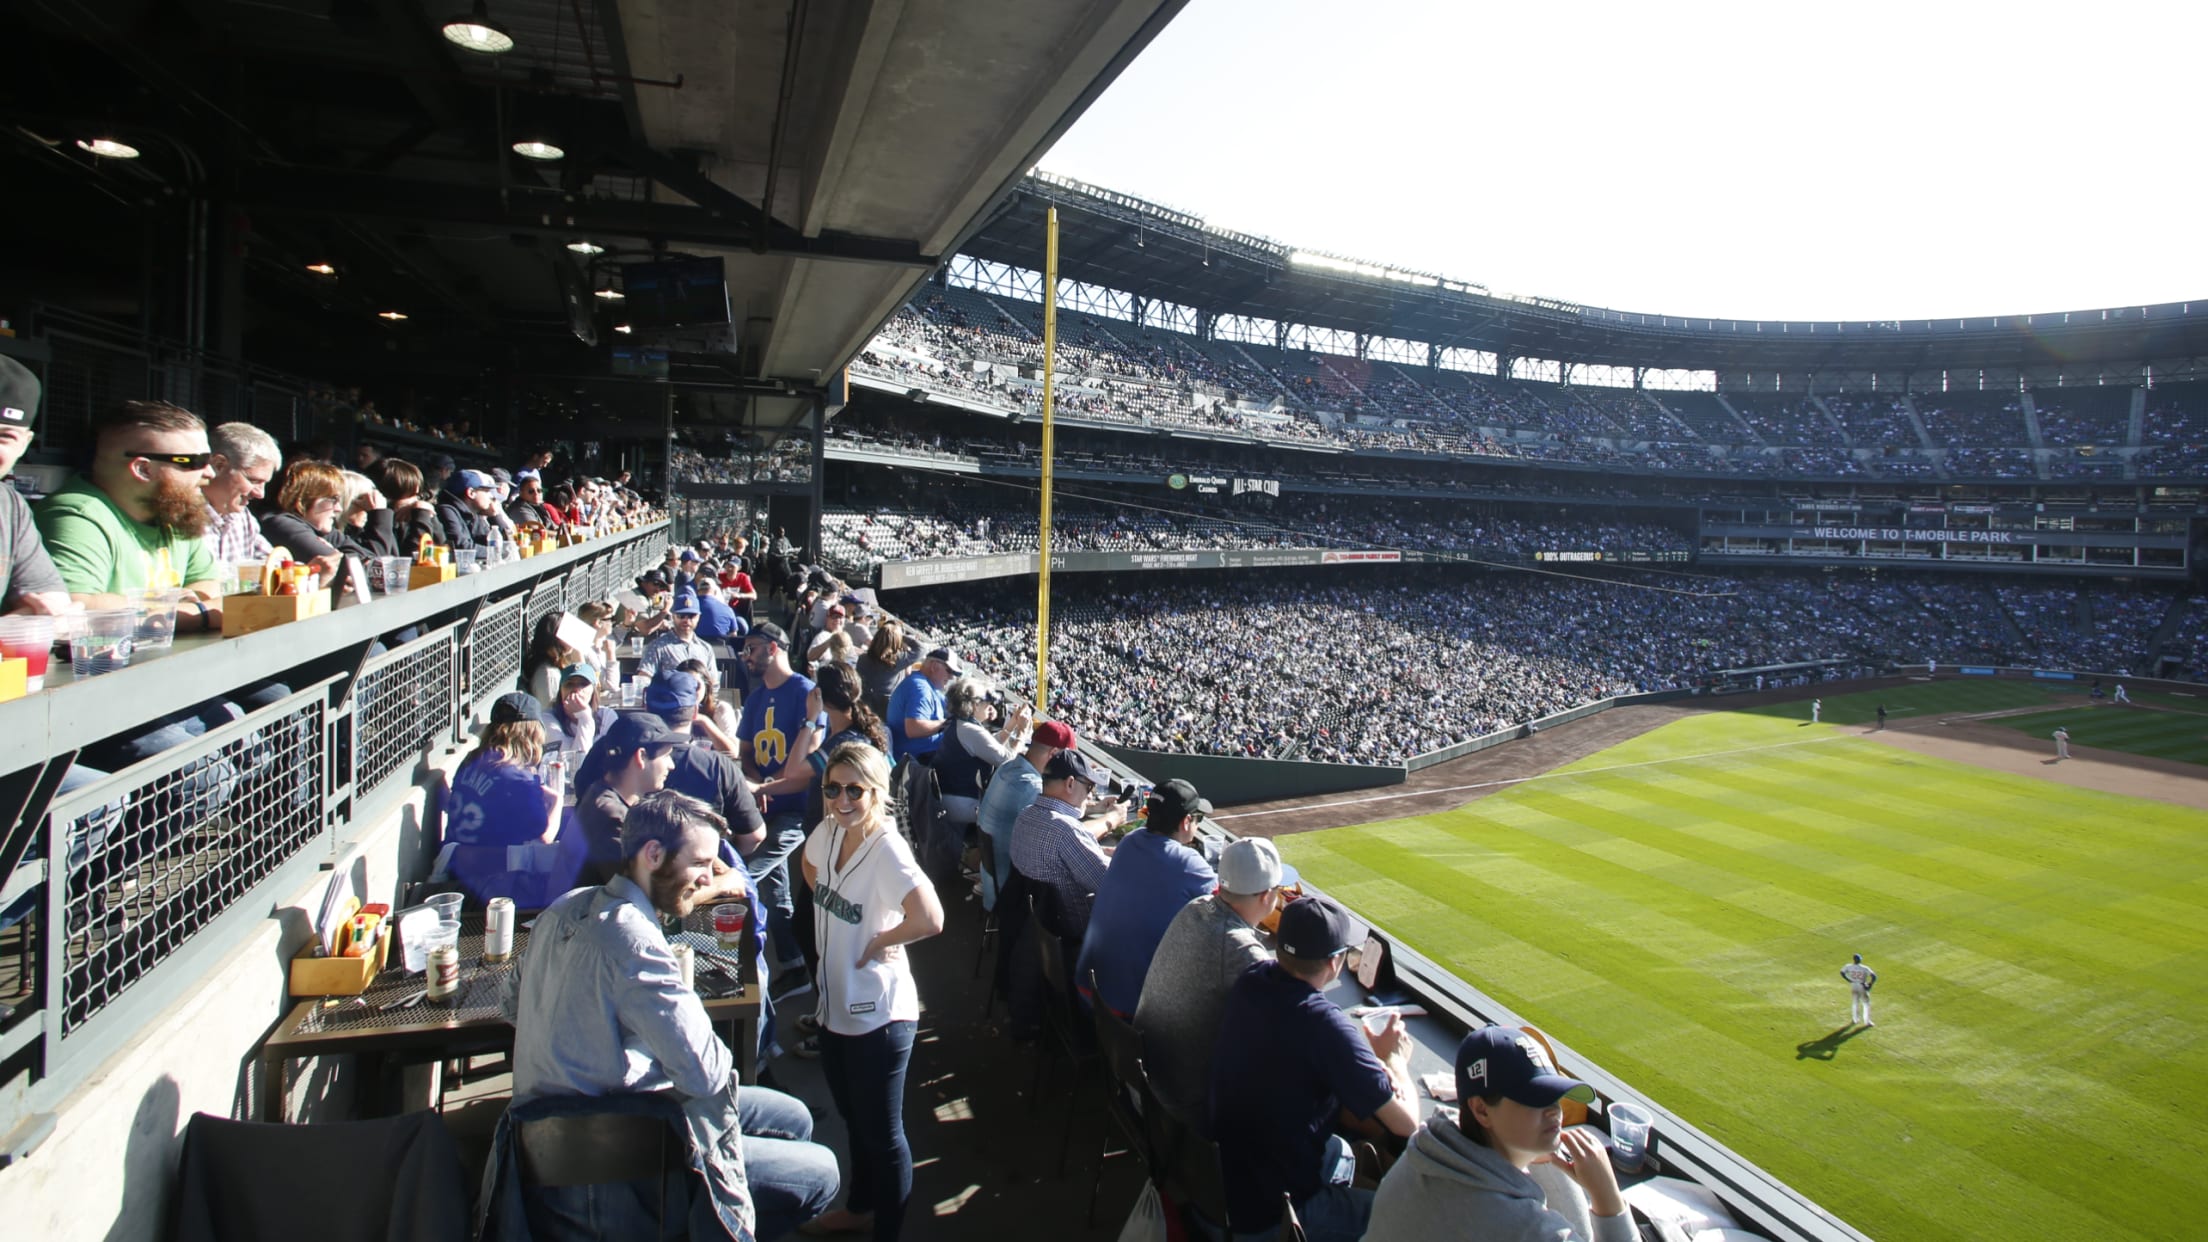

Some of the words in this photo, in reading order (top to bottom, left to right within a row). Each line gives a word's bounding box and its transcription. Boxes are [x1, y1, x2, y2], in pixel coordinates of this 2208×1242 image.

[1263, 480, 1280, 498] CLUB
[1814, 527, 1877, 540] WELCOME
[1881, 529, 1899, 540] TO
[1903, 529, 1968, 542] T-MOBILE
[1971, 531, 2011, 543] PARK
[1559, 551, 1595, 562] OUTRAGEOUS
[1470, 1063, 1482, 1077] 12
